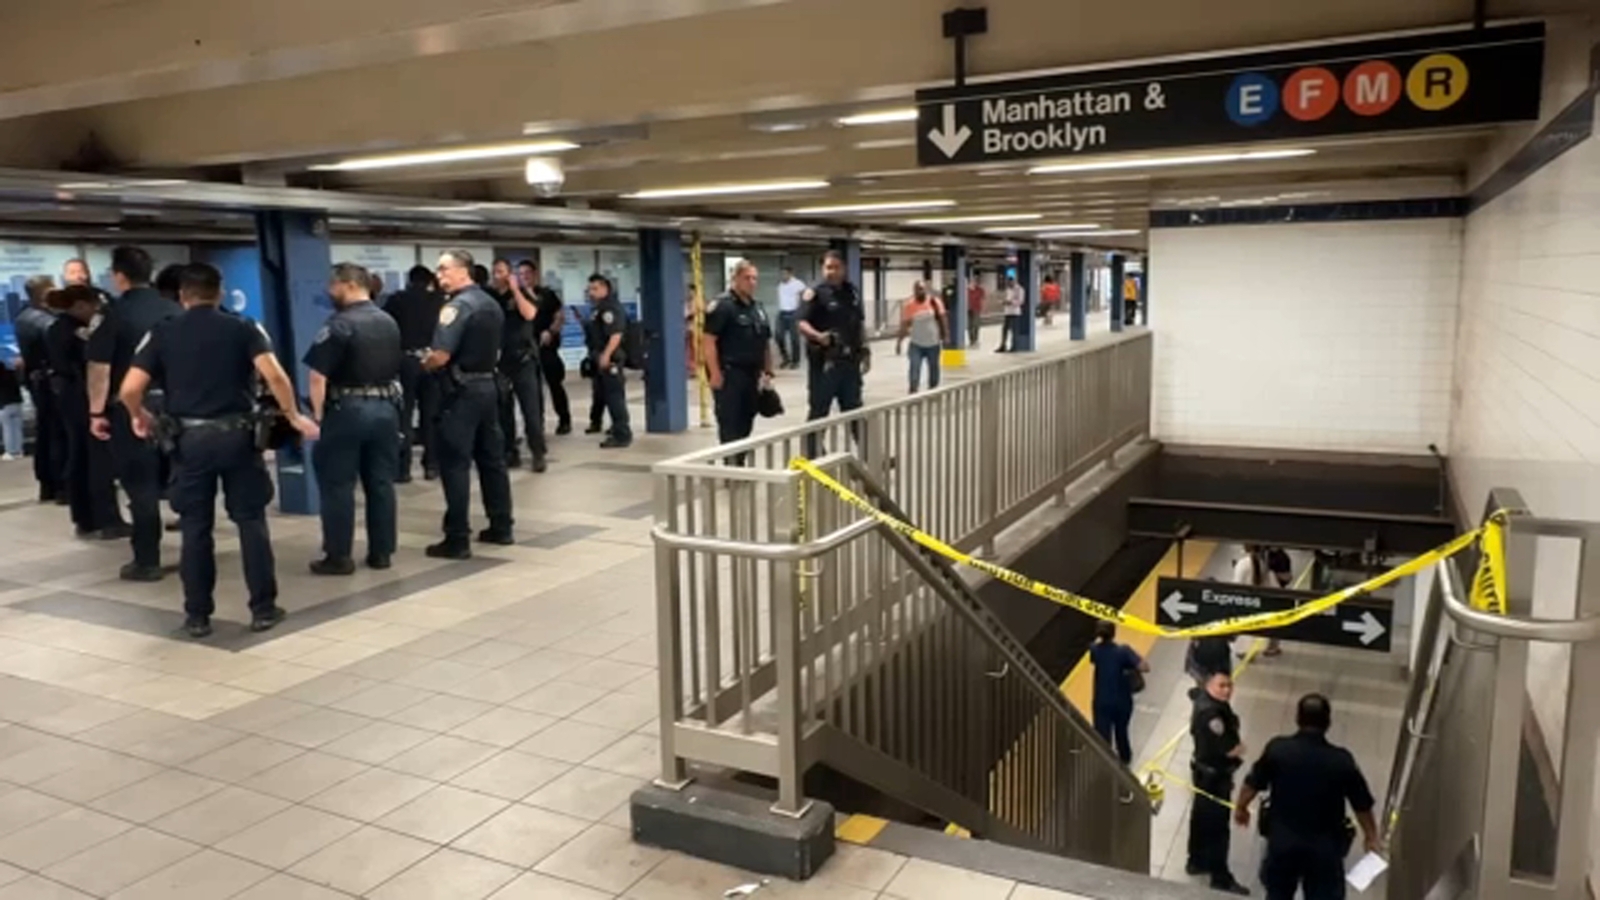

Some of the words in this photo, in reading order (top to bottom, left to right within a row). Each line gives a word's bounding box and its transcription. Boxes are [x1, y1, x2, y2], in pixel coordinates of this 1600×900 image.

[982, 91, 1131, 125] Manhattan
[1143, 82, 1166, 110] &
[1239, 84, 1264, 116] E
[1298, 79, 1324, 110] F
[1356, 72, 1389, 105] M
[1424, 67, 1454, 98] R
[983, 122, 1107, 154] Brooklyn
[1202, 589, 1261, 608] Express
